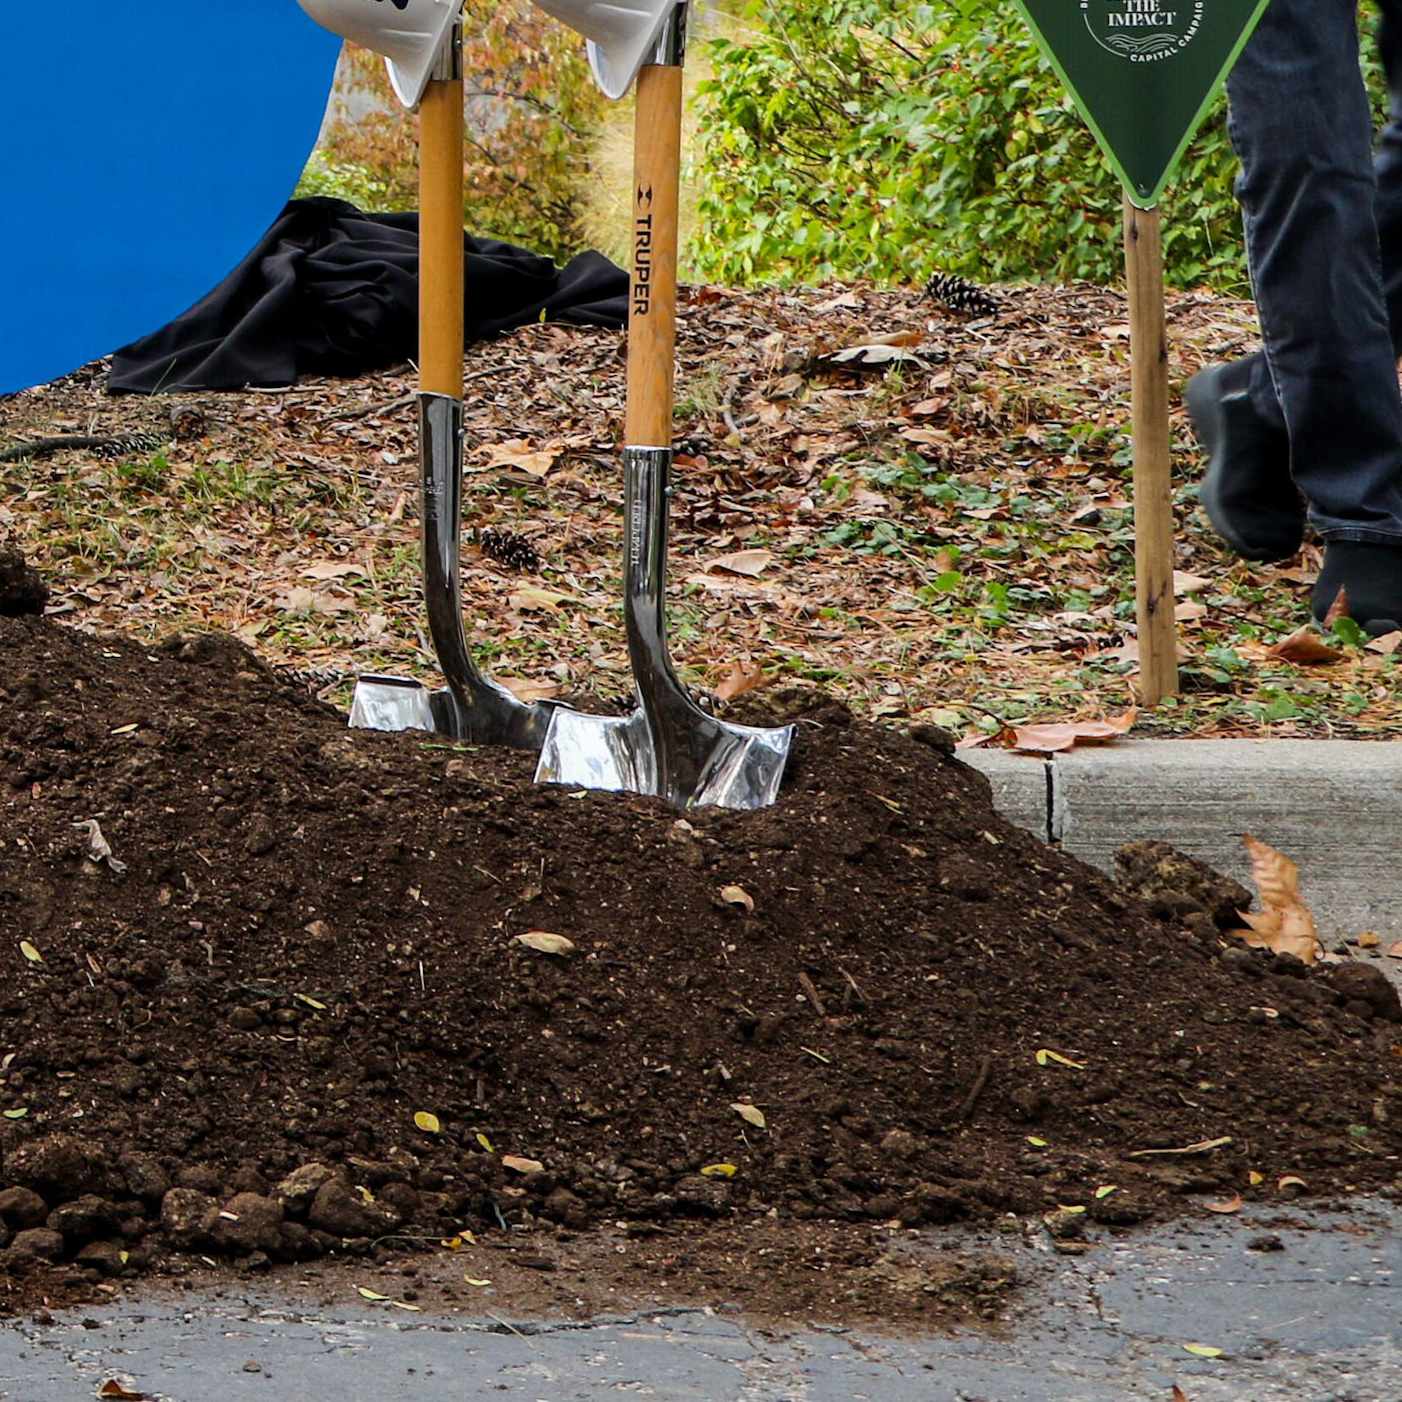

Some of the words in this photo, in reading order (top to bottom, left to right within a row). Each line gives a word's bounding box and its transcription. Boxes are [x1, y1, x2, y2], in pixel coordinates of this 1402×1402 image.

[1123, 0, 1161, 13] THE
[1108, 12, 1177, 26] IMPACT
[1130, 47, 1178, 62] CAPITAL
[634, 213, 652, 316] TRUPER
